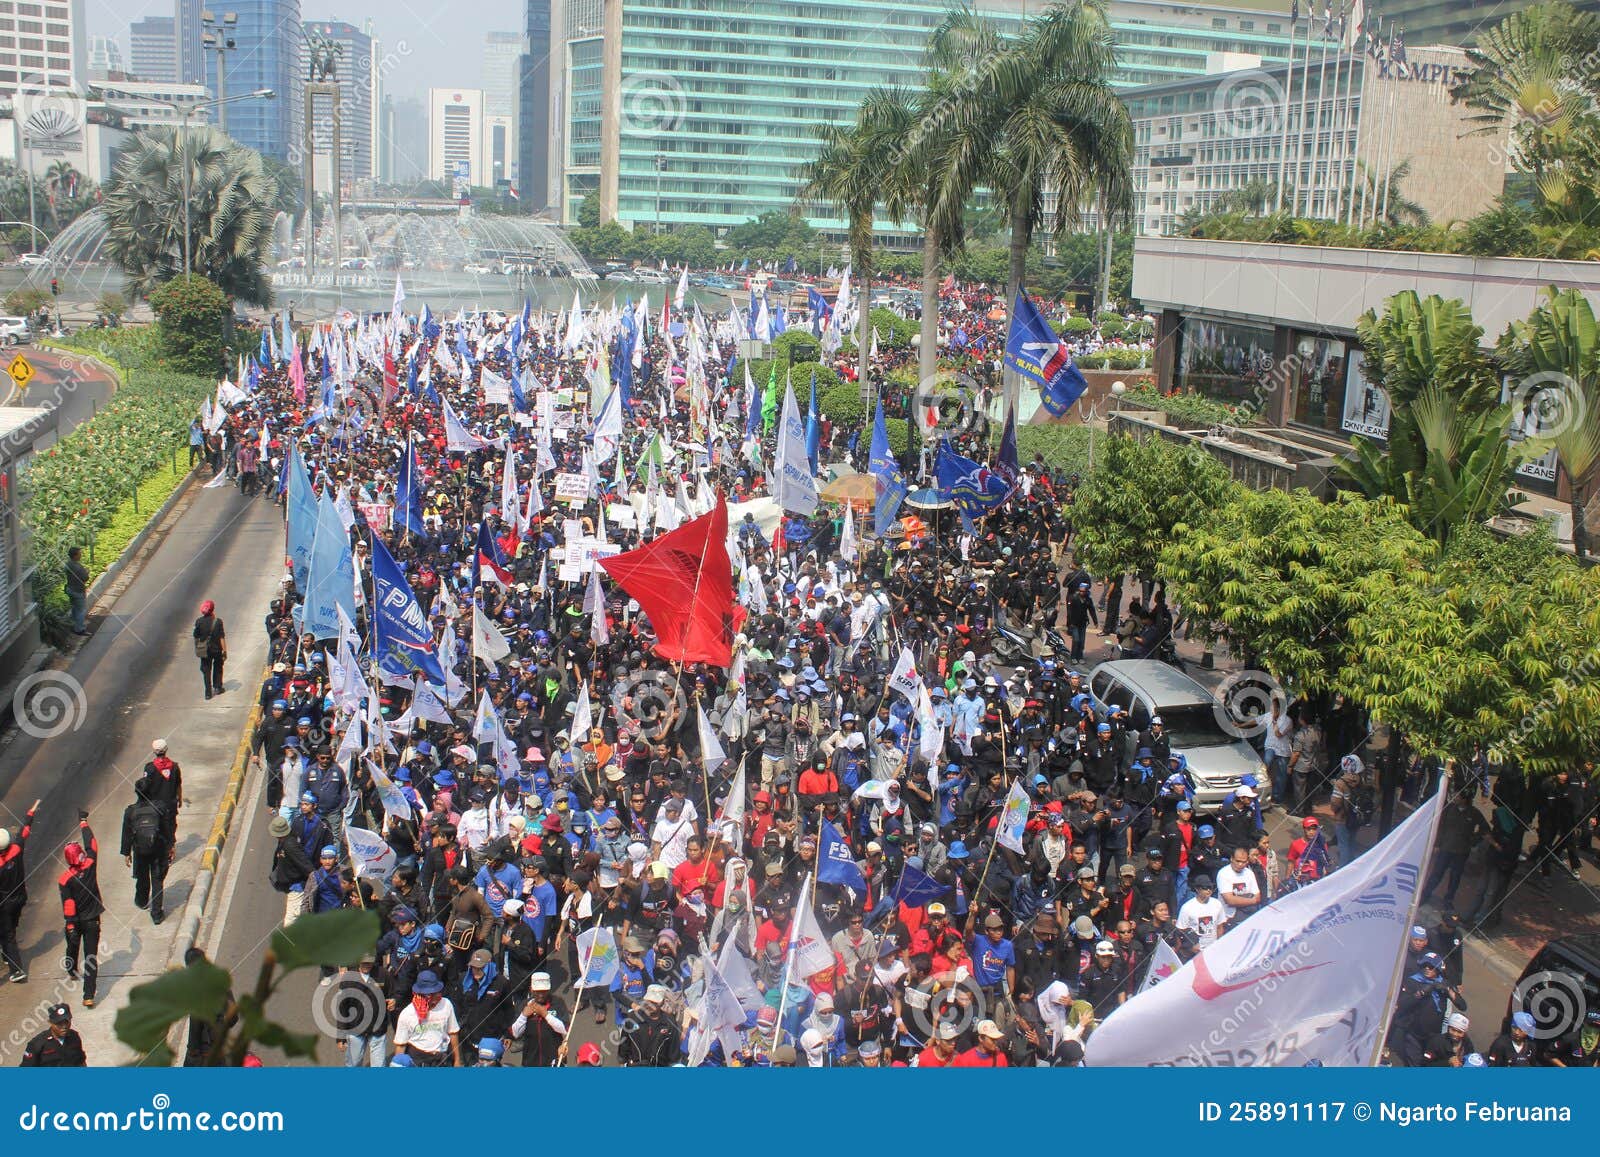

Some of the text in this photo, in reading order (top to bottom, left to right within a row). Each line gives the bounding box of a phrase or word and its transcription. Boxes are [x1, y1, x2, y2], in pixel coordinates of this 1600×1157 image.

[1344, 420, 1389, 438] DKNY JEANS
[1521, 465, 1555, 480] JEANS
